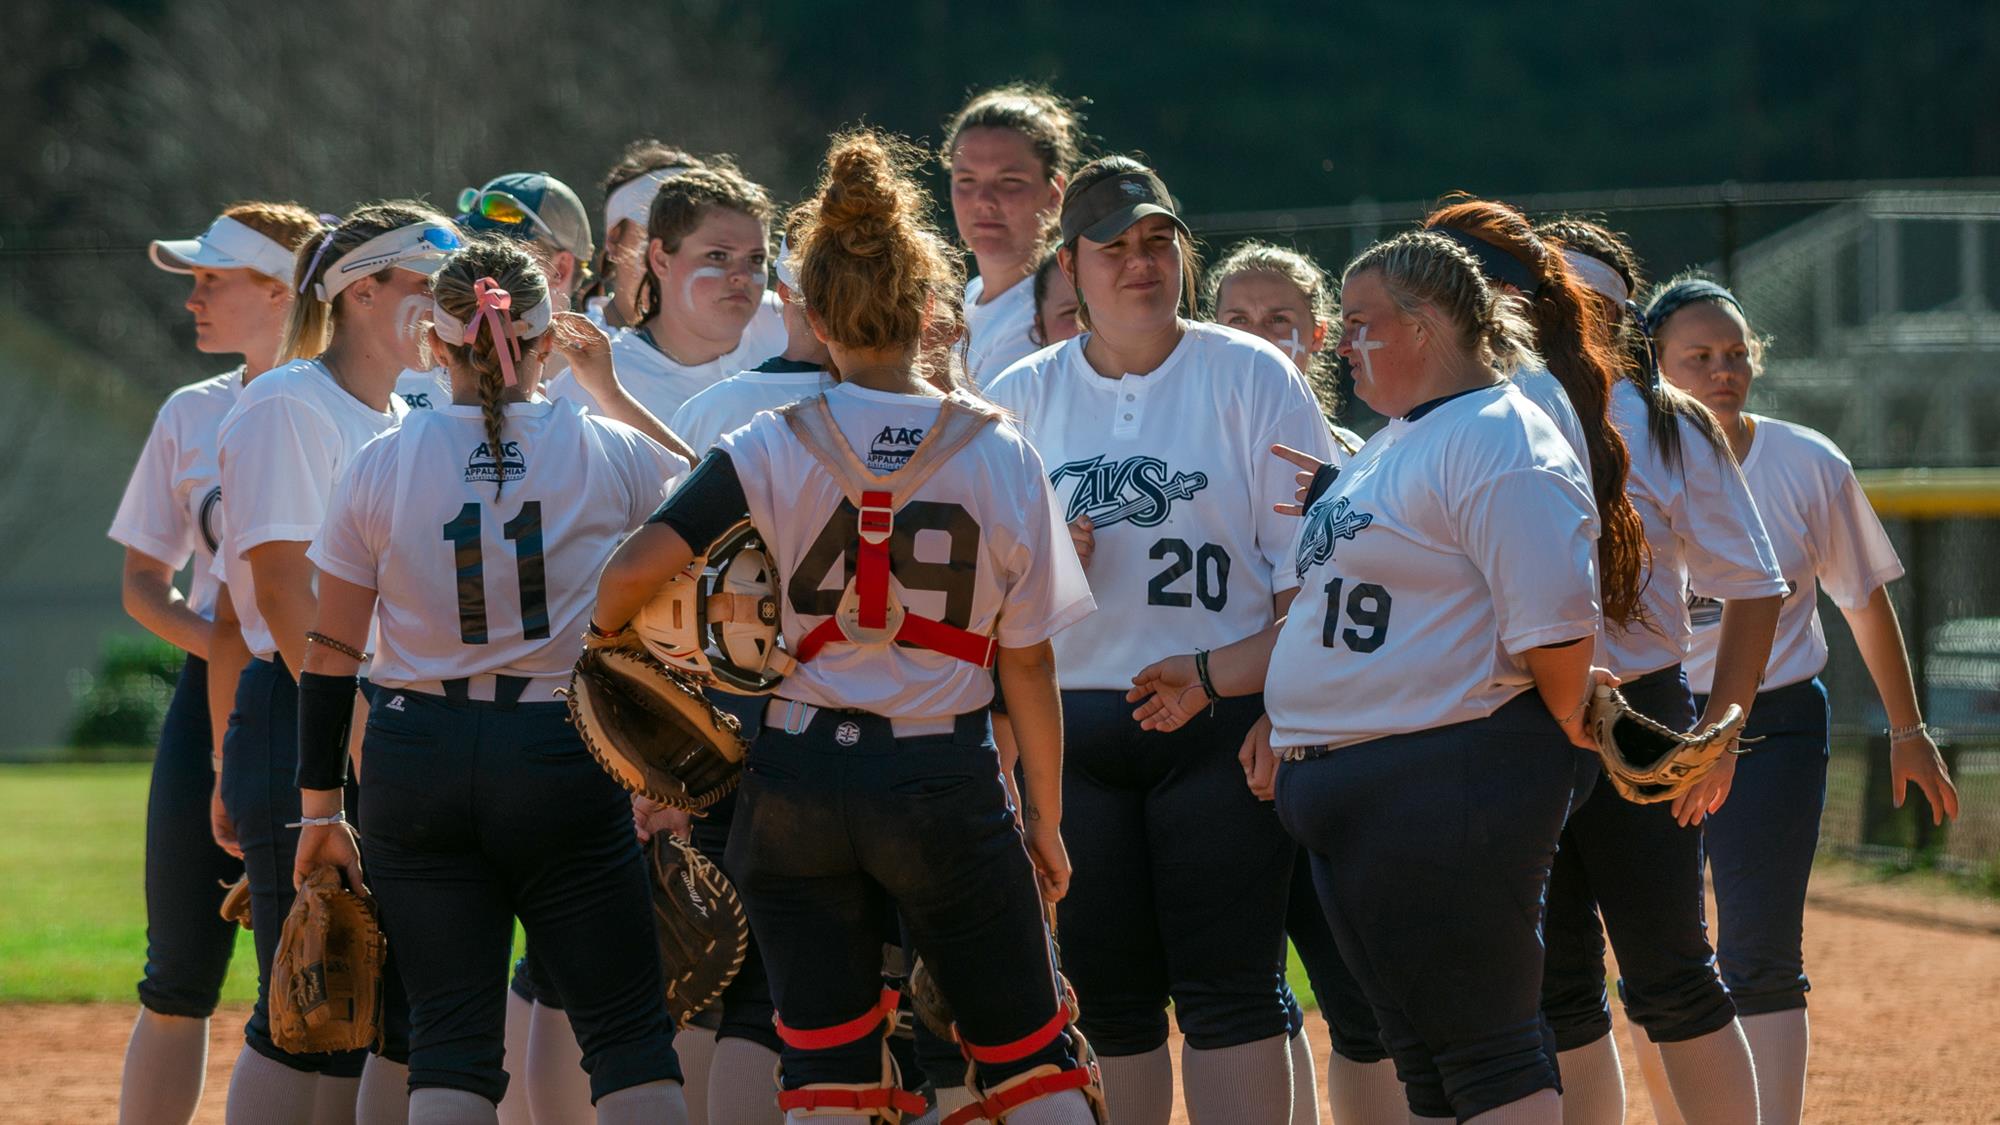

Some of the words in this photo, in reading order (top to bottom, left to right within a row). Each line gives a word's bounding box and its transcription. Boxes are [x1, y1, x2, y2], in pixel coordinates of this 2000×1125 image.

[464, 467, 526, 476] APPALAHIAN
[867, 454, 910, 465] APPALAC
[879, 426, 923, 446] AAC
[443, 501, 551, 645] 11
[788, 496, 981, 631] 49
[1147, 537, 1232, 613] 20
[1322, 577, 1393, 653] 19
